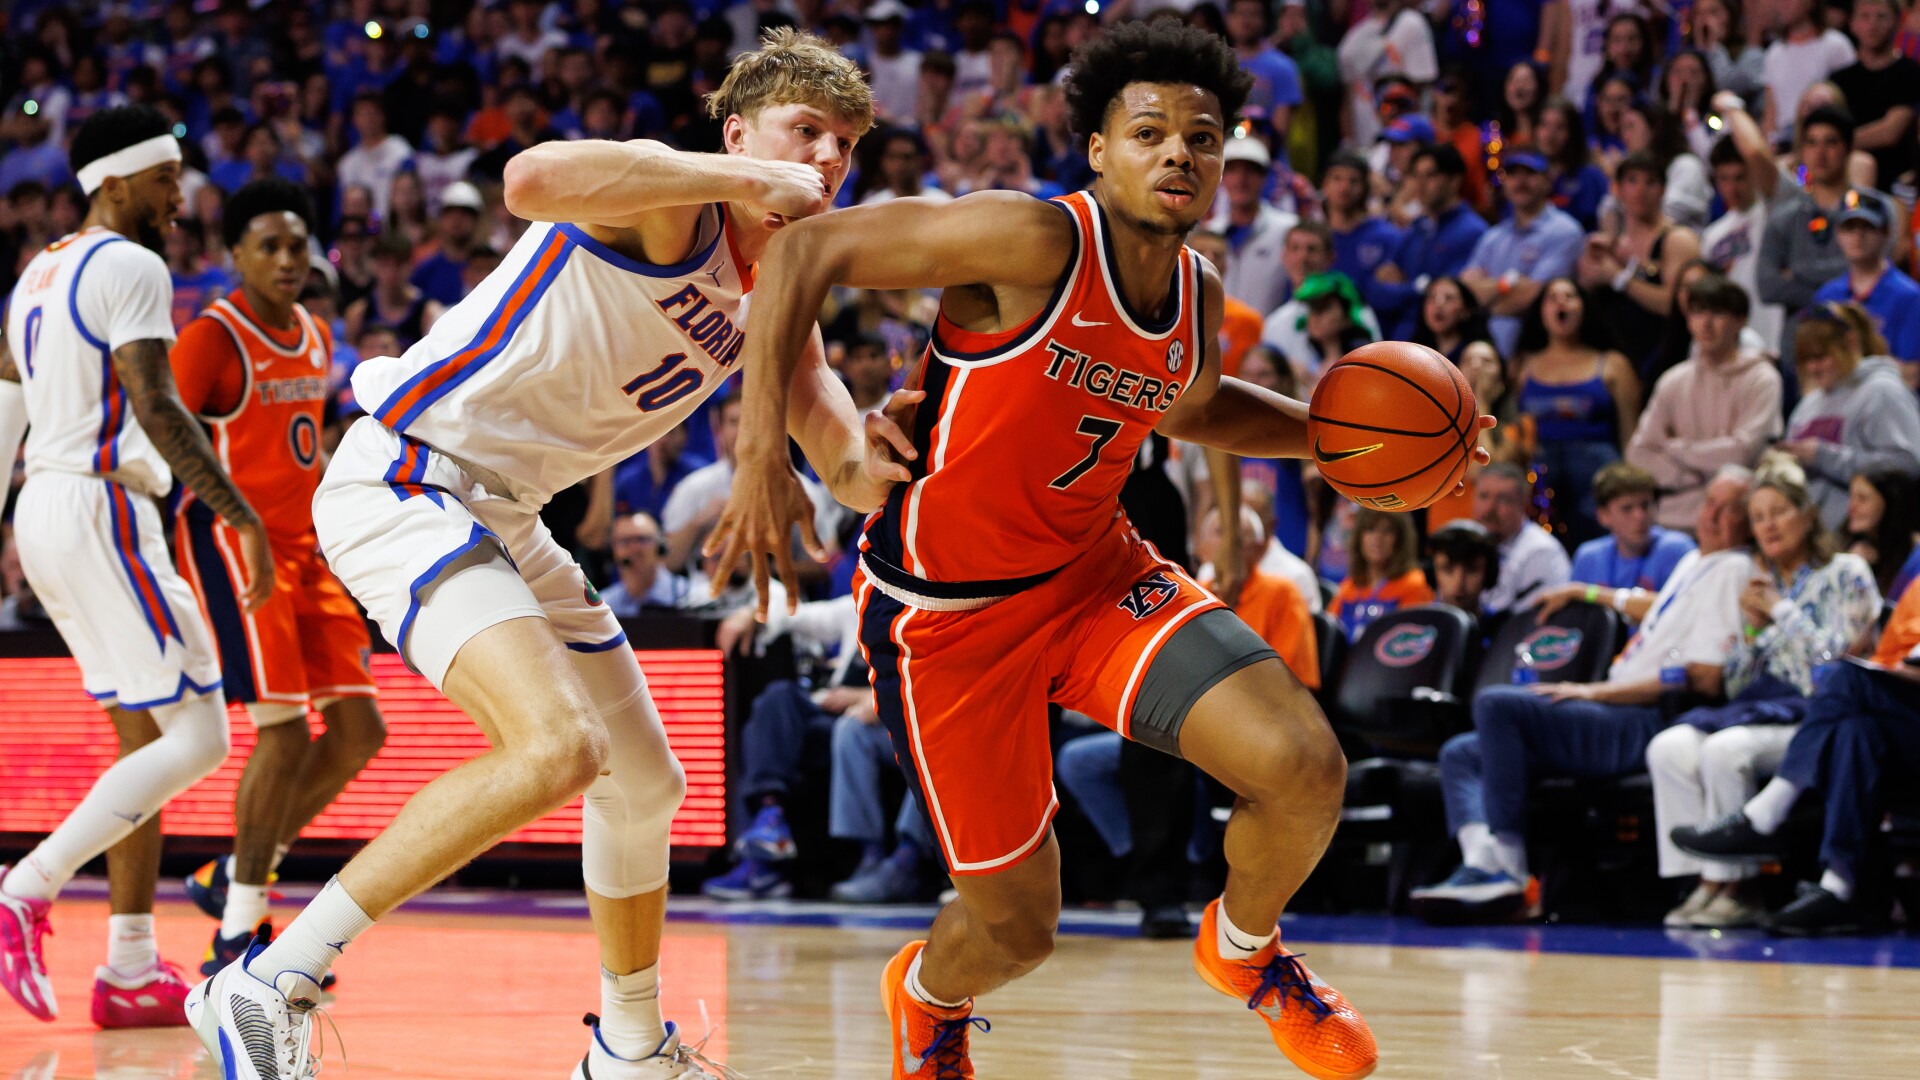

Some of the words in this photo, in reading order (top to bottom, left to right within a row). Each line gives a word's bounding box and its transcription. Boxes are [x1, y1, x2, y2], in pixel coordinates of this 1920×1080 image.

[24, 305, 42, 380] 0
[1044, 338, 1183, 413] TIGERS
[1168, 340, 1184, 372] SEC
[621, 352, 705, 413] 10
[288, 411, 320, 471] 0
[1047, 414, 1125, 490] 7
